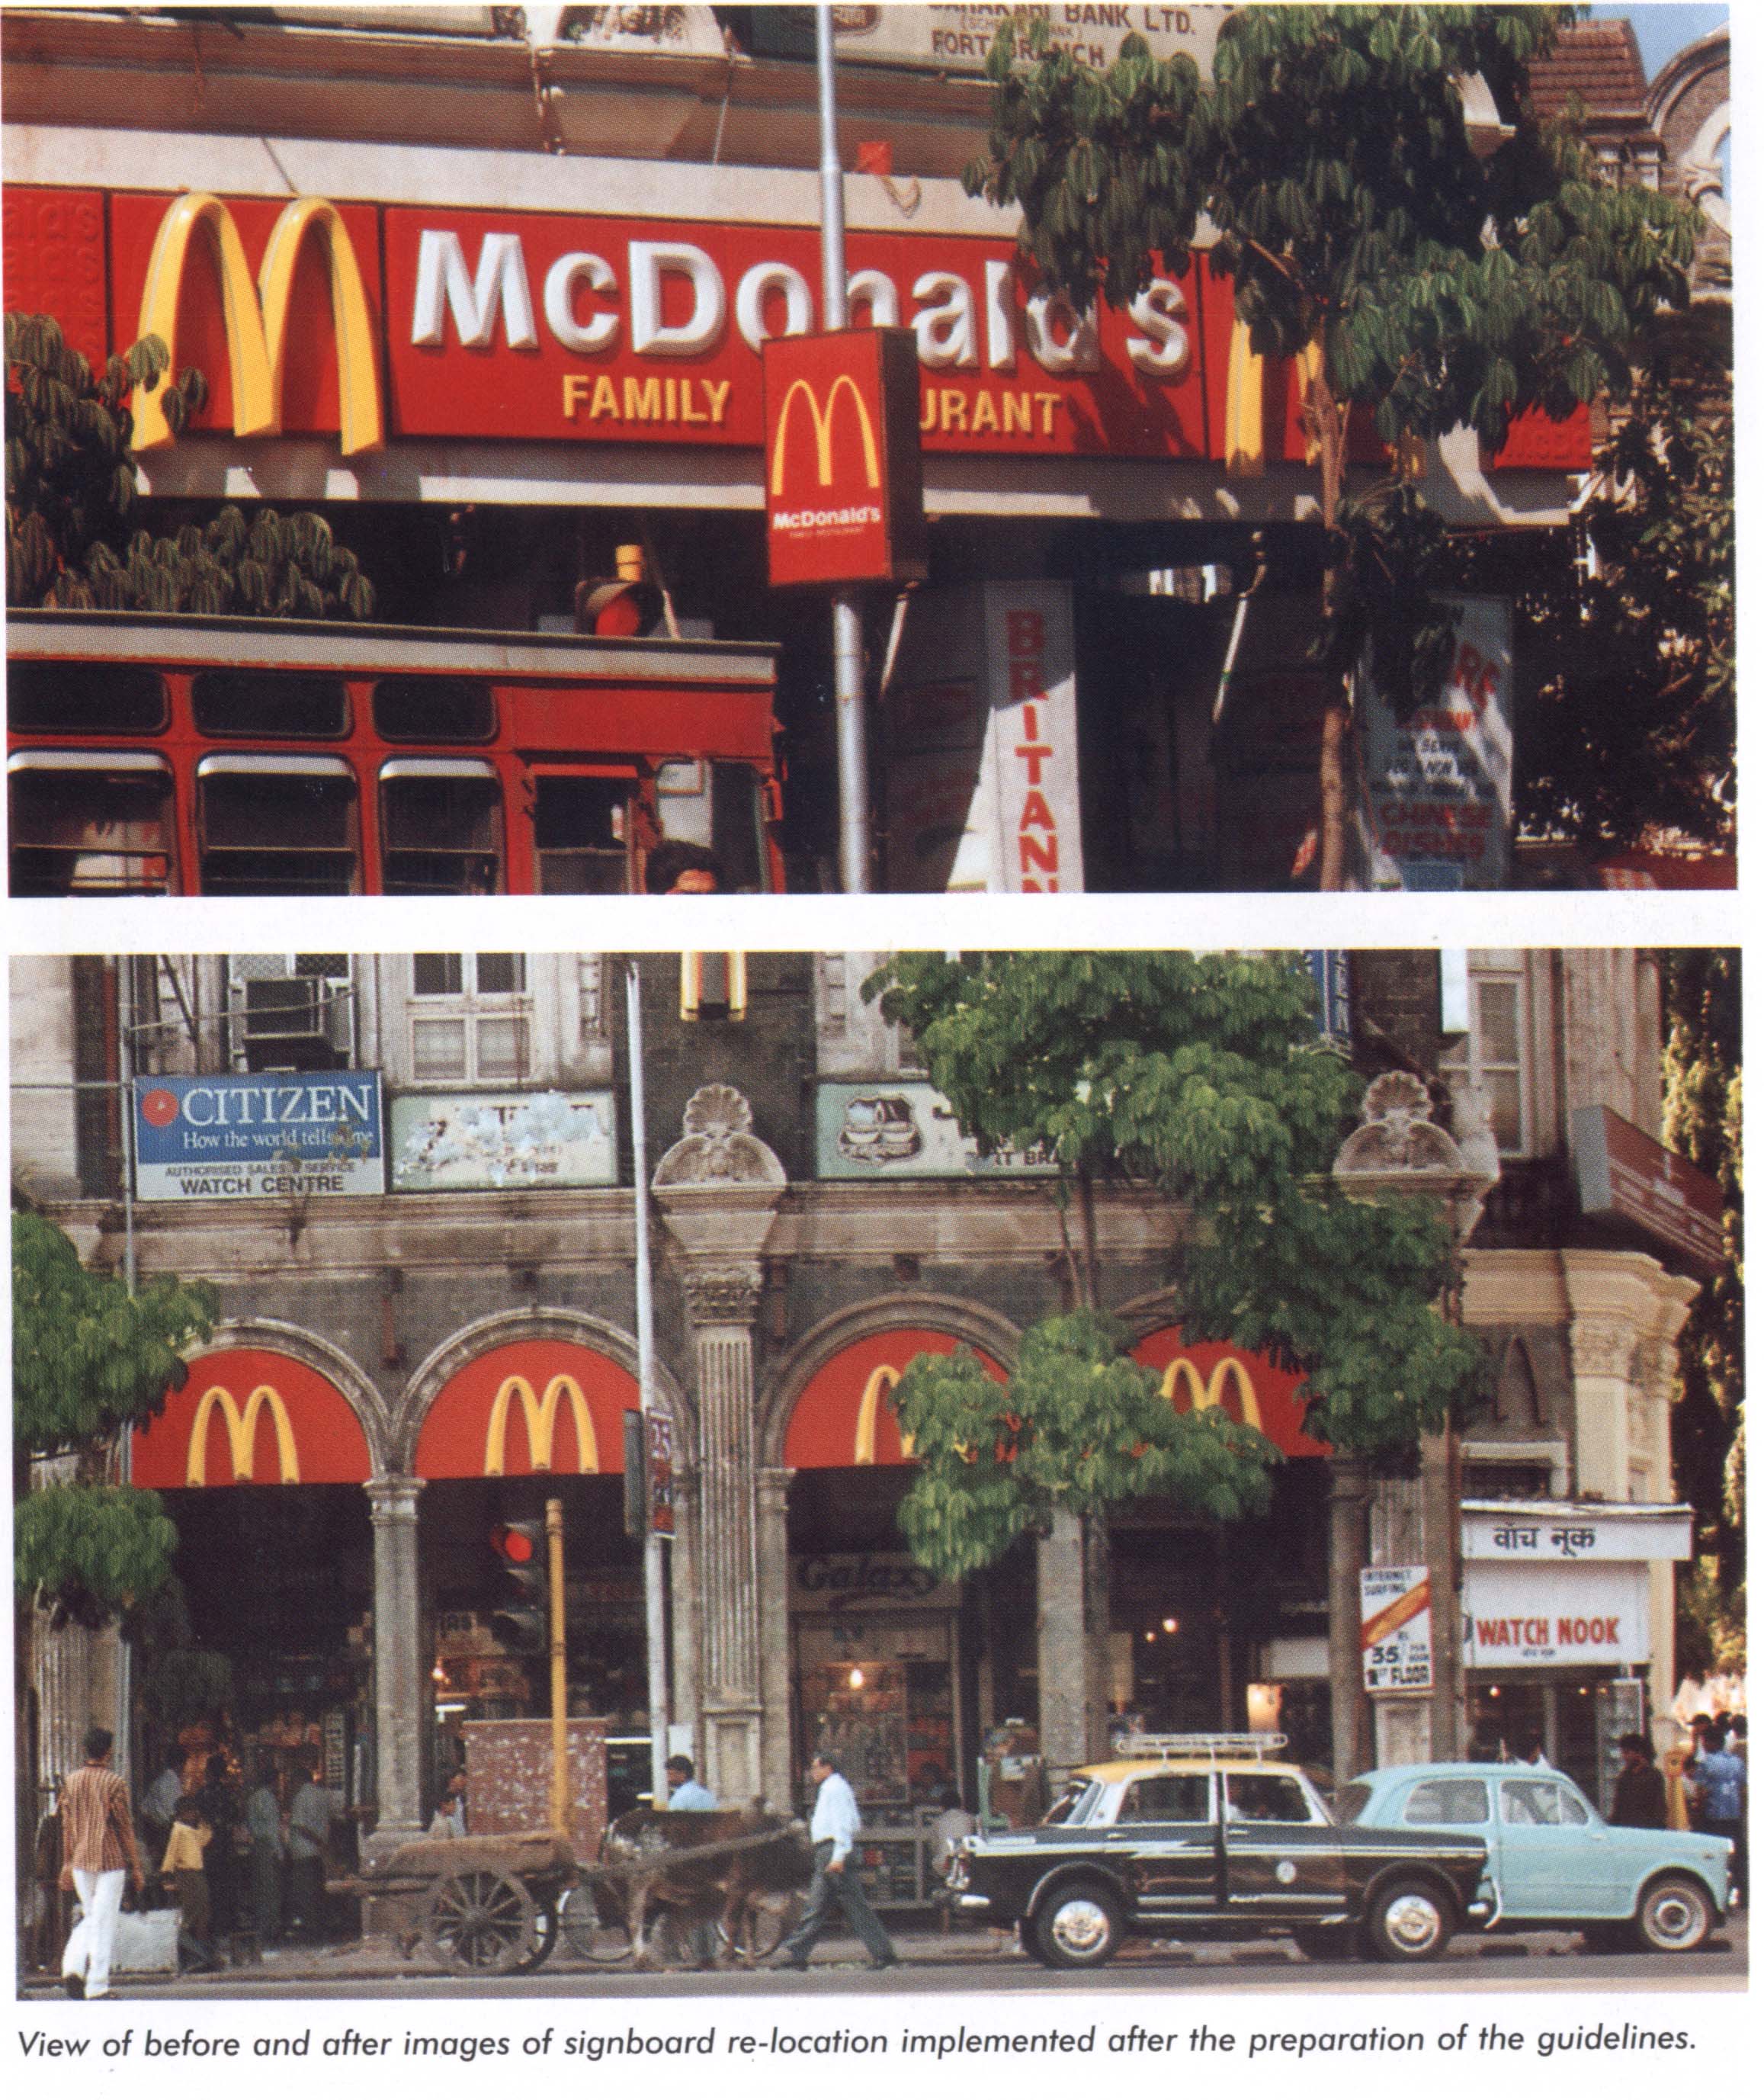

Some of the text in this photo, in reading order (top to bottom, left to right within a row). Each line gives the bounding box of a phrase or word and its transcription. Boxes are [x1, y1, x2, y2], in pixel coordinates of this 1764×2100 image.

[1145, 6, 1195, 35] LTD.
[932, 30, 989, 55] FORT
[411, 229, 1189, 376] McDonalds
[563, 374, 1063, 435] FAMILY URANT
[772, 506, 882, 530] McDonald's
[181, 1084, 373, 1127] CITIZEN
[184, 1131, 220, 1150] How
[224, 1132, 248, 1148] the
[252, 1129, 297, 1147] world
[180, 1175, 344, 1195] WATCH CENTRE
[1551, 1527, 1596, 1557] नूक
[1476, 1616, 1619, 1647] WATCH NOOK
[1371, 1645, 1400, 1664] 35
